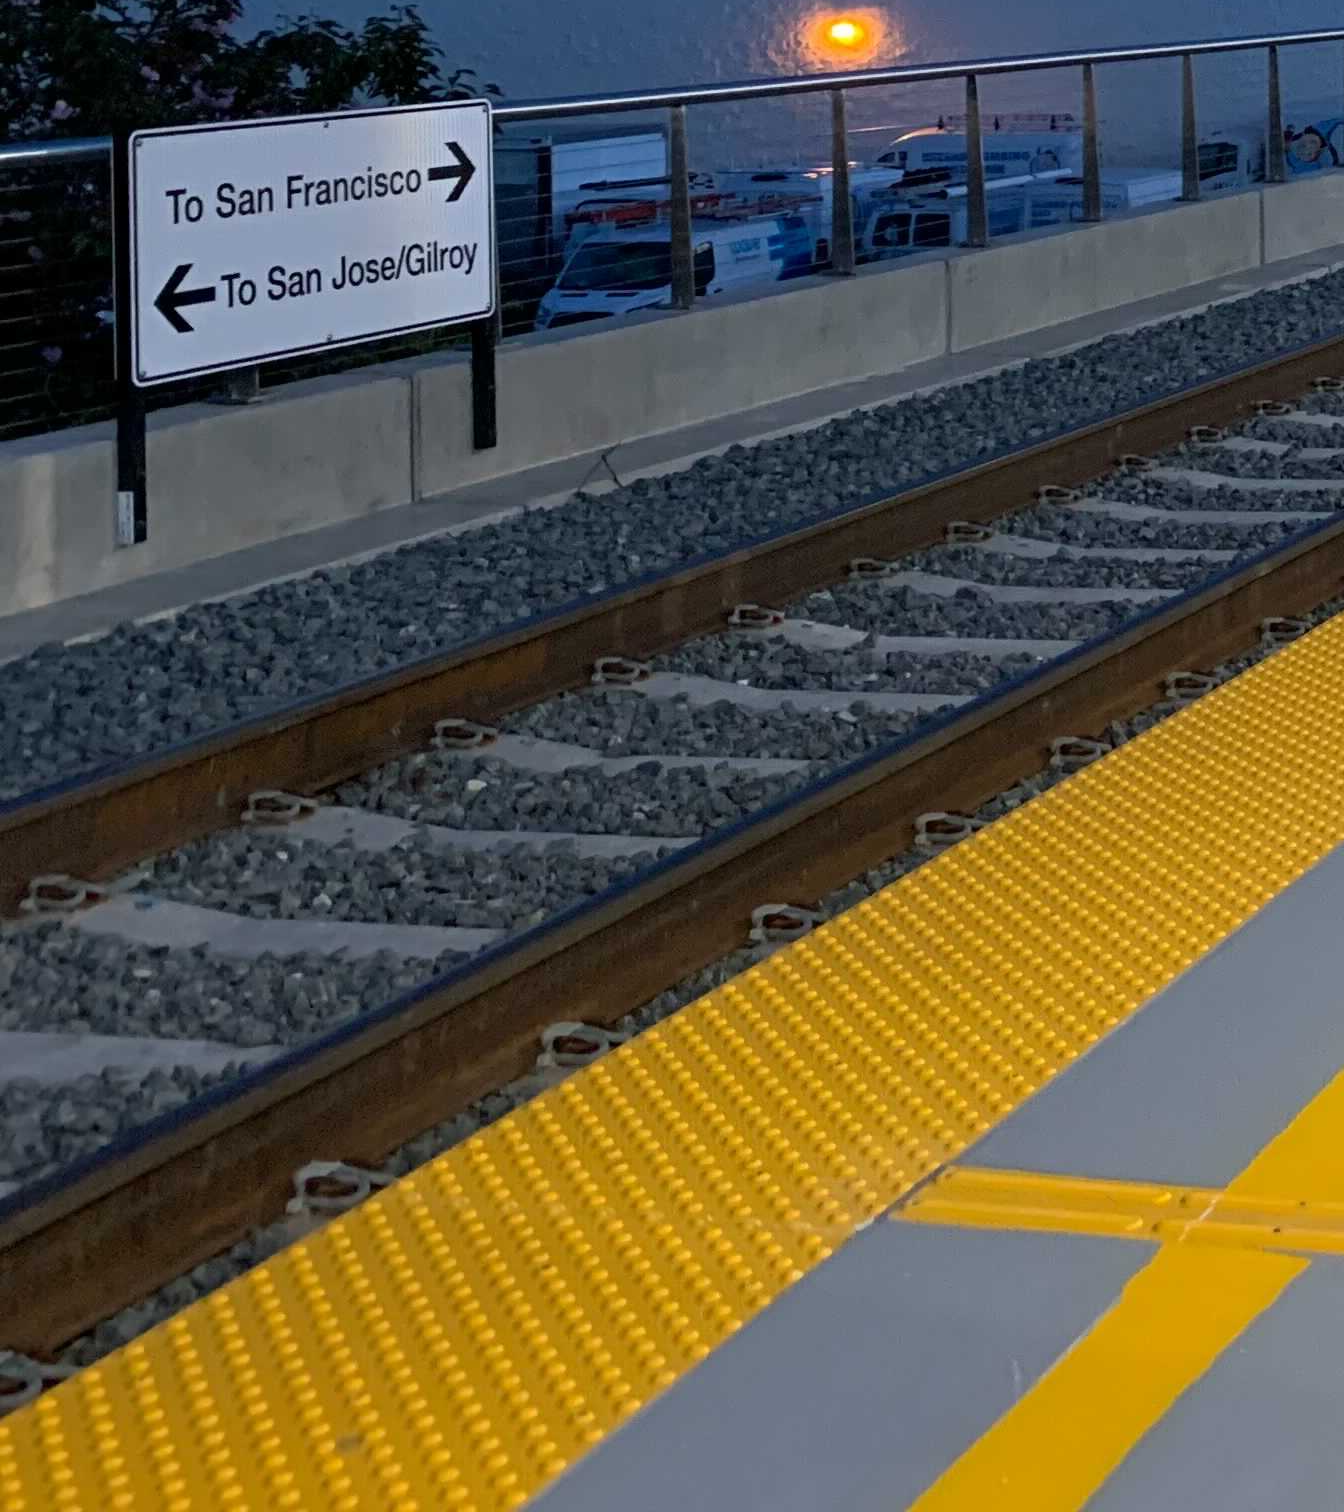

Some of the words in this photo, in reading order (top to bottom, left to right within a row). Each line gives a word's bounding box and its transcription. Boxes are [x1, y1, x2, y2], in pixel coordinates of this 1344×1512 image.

[165, 188, 204, 224] To
[216, 183, 274, 219] San
[287, 167, 421, 209] Francisco
[220, 272, 257, 307] To
[268, 266, 321, 301] San
[332, 242, 477, 290] Jose/Gilroy
